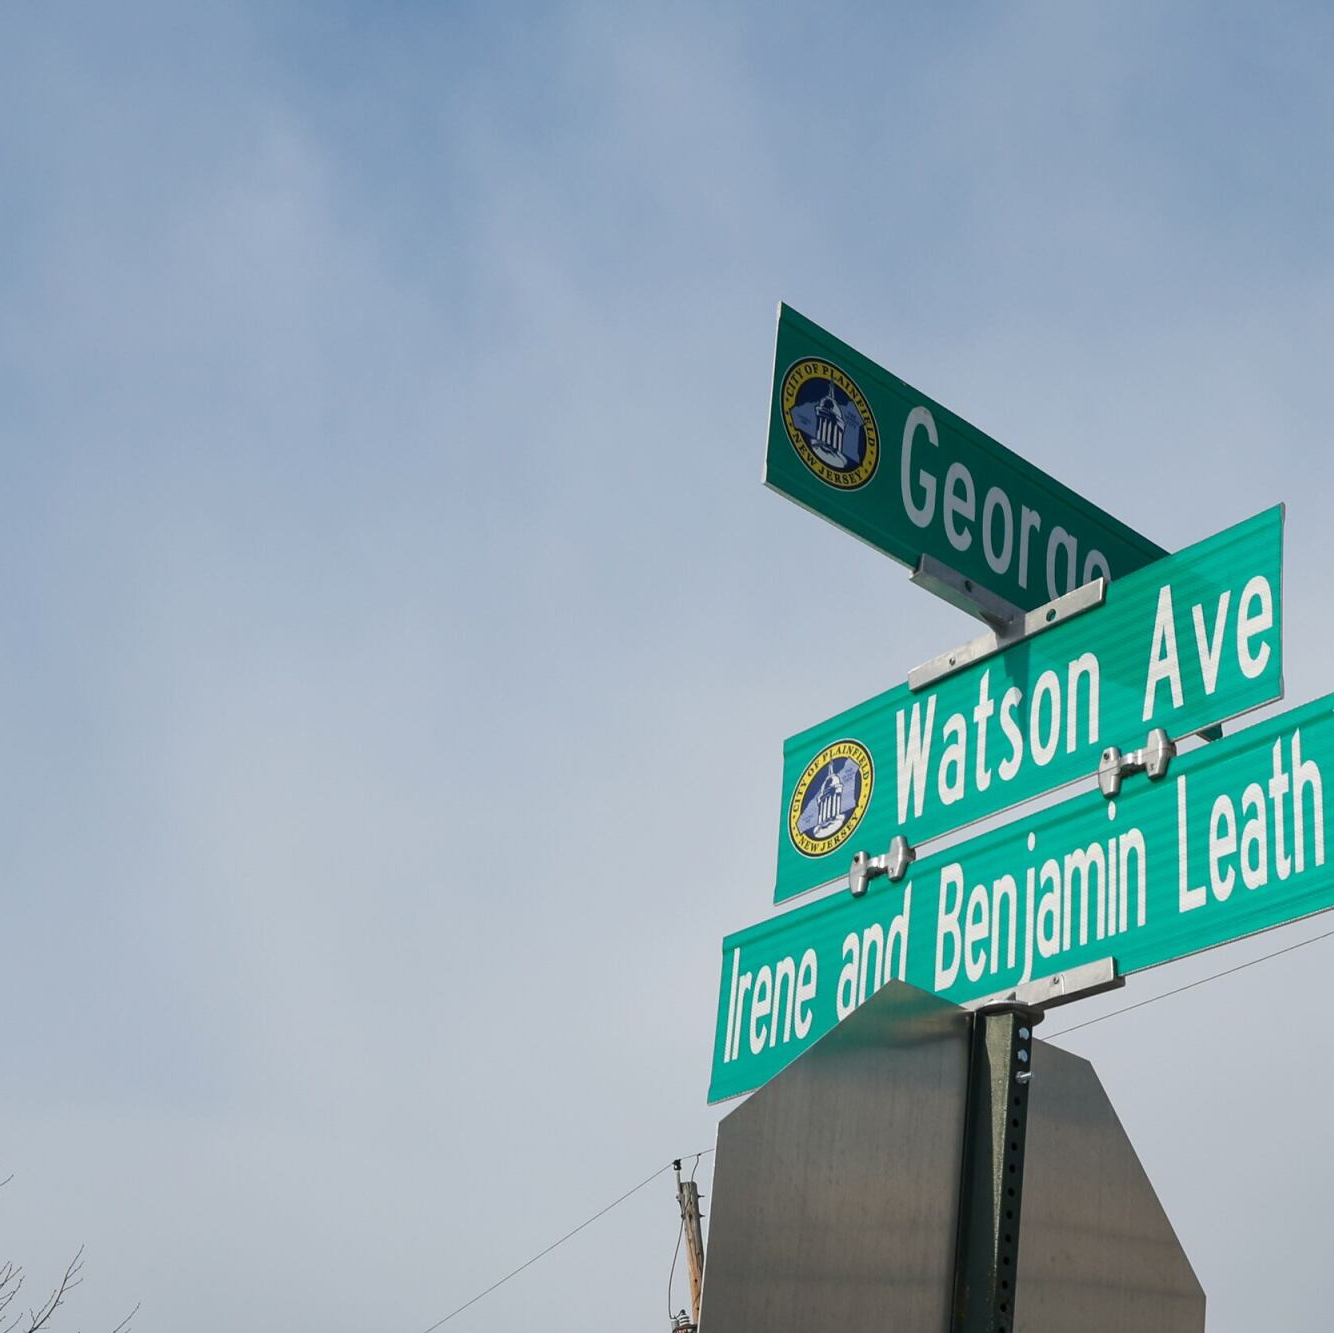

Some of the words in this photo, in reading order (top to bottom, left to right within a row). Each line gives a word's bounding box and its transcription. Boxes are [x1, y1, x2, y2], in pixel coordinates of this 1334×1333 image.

[785, 367, 804, 398] CITY
[804, 363, 820, 375] OF
[821, 364, 876, 447] PLAINFIELD
[792, 432, 817, 466] NEW
[818, 465, 864, 485] JERSEY
[894, 648, 1101, 826] Watson
[1142, 574, 1273, 721] Ave
[792, 780, 807, 813] CITY
[807, 761, 821, 777] OF
[822, 746, 870, 781] PLAINFIELD
[798, 836, 820, 853] NEW
[819, 813, 859, 852] JERSEY
[723, 944, 818, 1065] Irene
[836, 882, 911, 1019] and
[934, 801, 1146, 984] Benjamin
[1177, 727, 1324, 911] Leath
